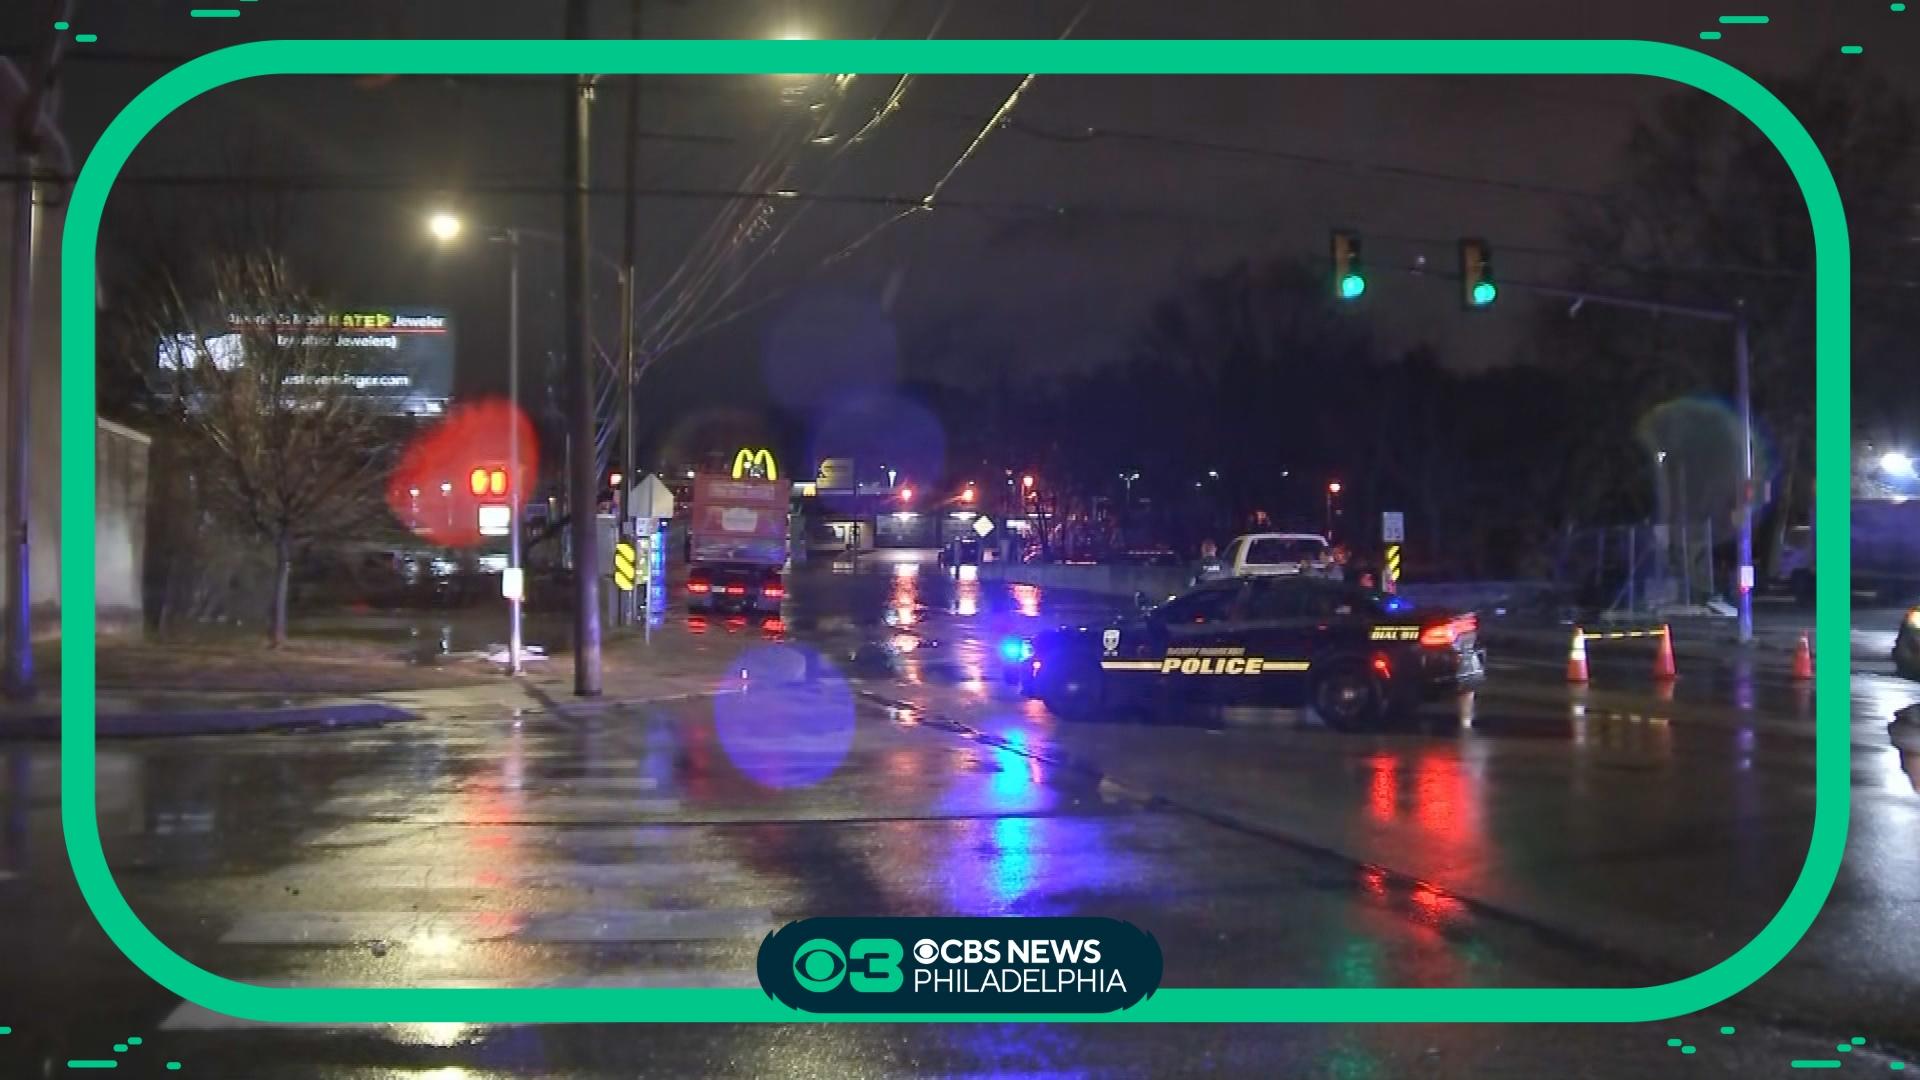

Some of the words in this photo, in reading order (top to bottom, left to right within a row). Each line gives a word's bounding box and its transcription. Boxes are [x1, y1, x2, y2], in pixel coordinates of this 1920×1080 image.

[392, 315, 446, 327] Jeweler
[1370, 631, 1398, 641] DIAL
[1400, 631, 1420, 641] 911
[1161, 658, 1264, 675] POLICE
